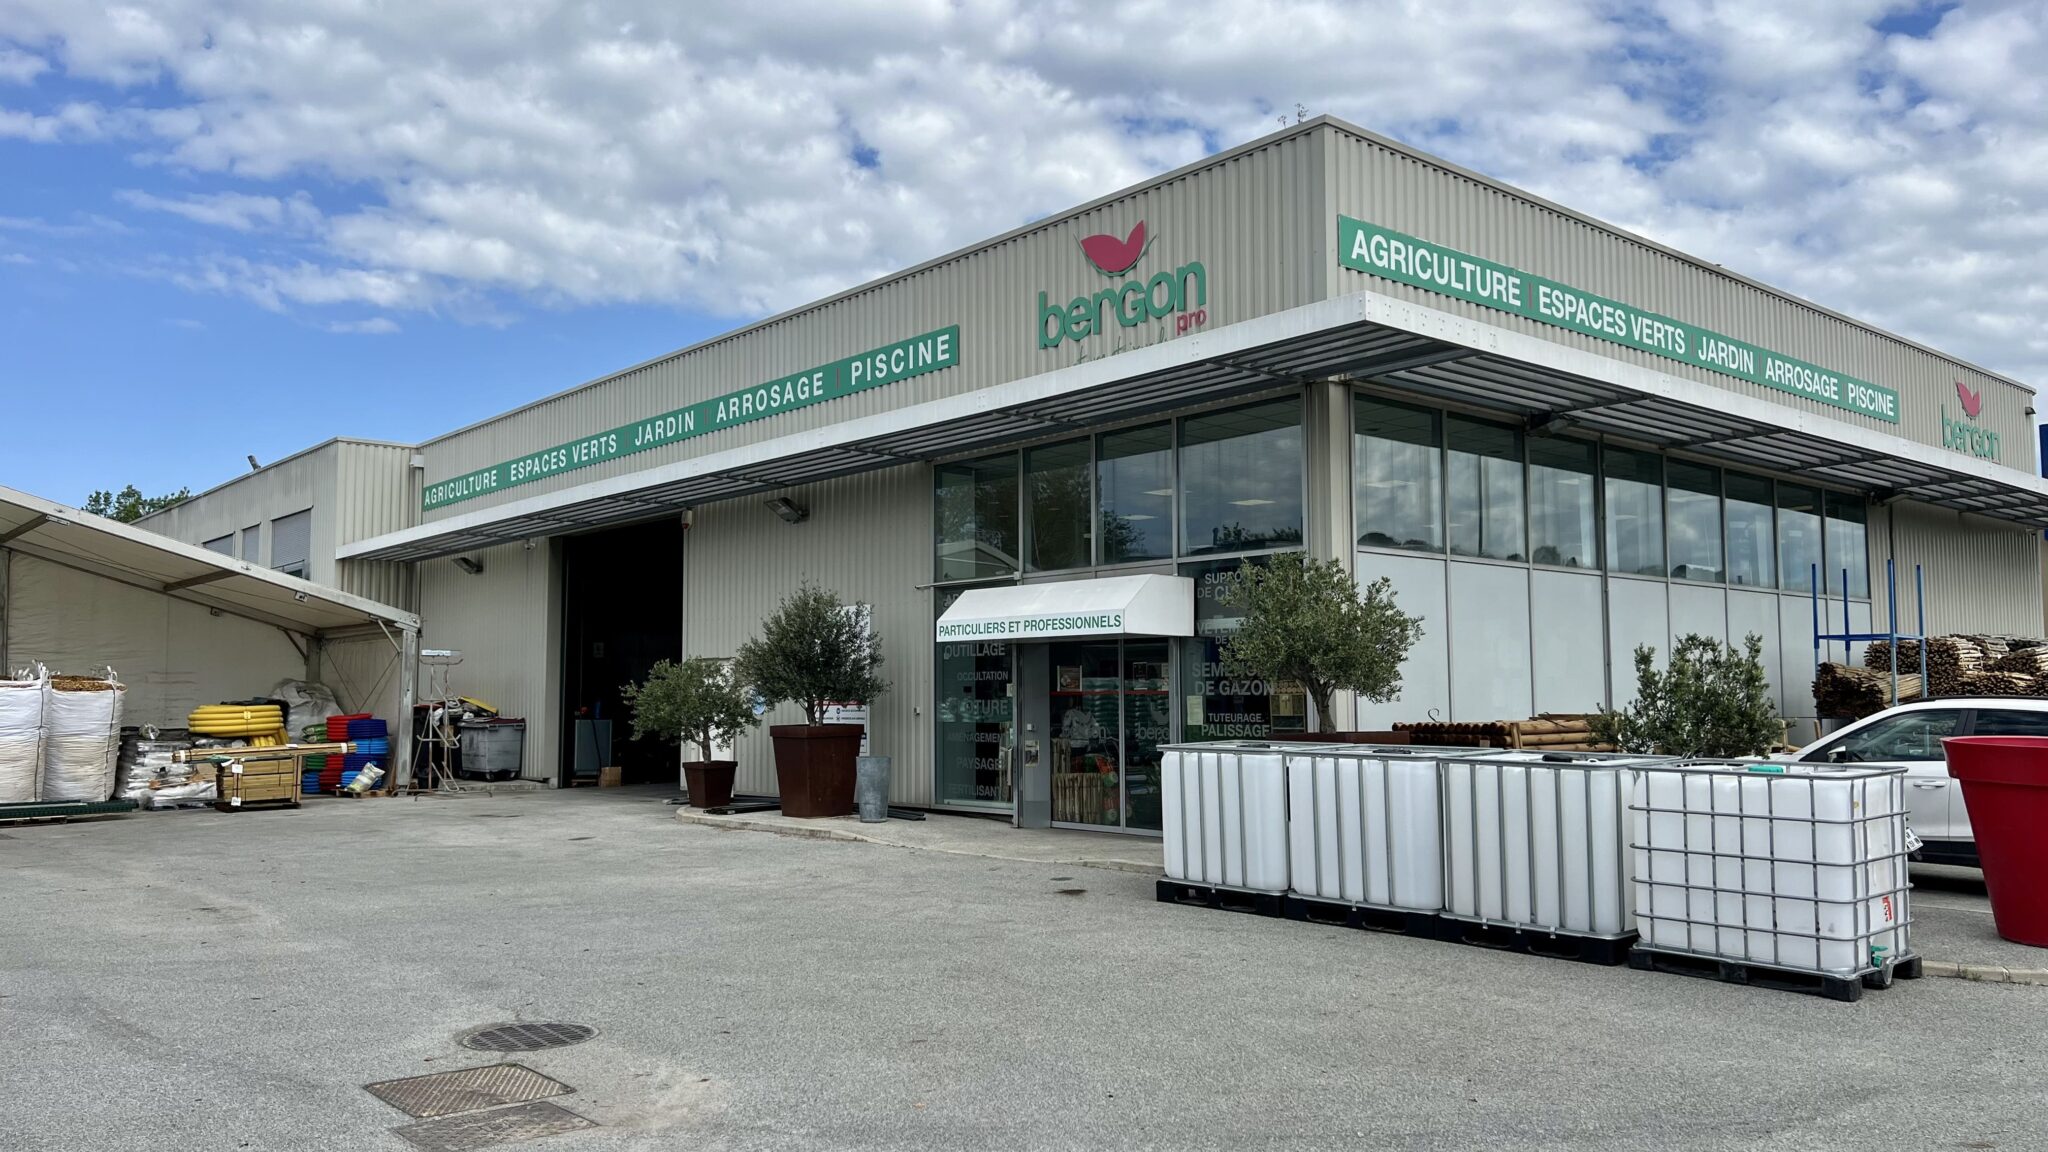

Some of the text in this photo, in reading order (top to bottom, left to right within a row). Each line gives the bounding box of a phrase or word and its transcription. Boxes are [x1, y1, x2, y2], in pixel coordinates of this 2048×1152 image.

[1176, 309, 1207, 336] pro
[1351, 229, 1895, 416] AGRICULTURE ESPACES VERTS JARDIN ARROSAGE PISCINE
[424, 334, 950, 505] AGRICULTURE ESPACES VERTS JARDIN ARROSAGE PISCINE
[1197, 587, 1211, 598] DE
[938, 614, 1122, 637] PARTICULIERS ET PROFESSIONNELS
[1215, 635, 1228, 645] DE
[944, 642, 1006, 658] OUTILLAGE
[956, 671, 1009, 681] OCCULTATION
[1194, 679, 1274, 696] DE GAZON
[1201, 723, 1270, 737] PALISSAGE
